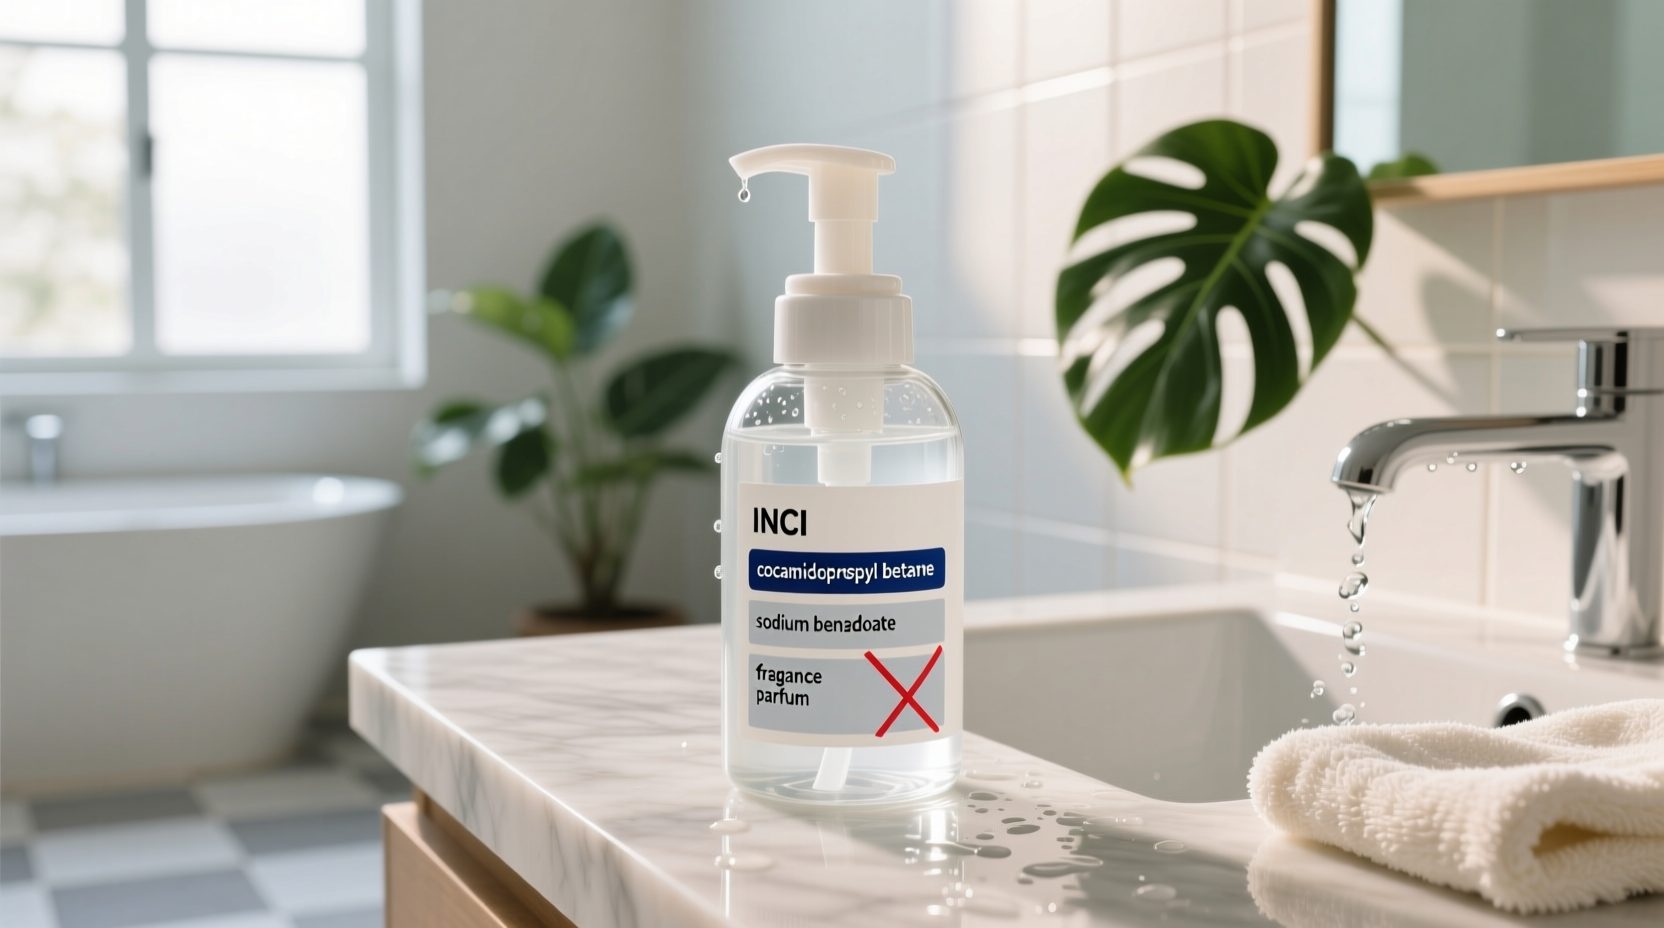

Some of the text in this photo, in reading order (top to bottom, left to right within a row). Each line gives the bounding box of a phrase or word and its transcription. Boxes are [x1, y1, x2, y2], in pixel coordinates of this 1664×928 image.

[753, 507, 807, 536] INCI
[755, 613, 810, 632] sodium
[755, 663, 823, 687] fragance
[756, 687, 810, 707] parfum
